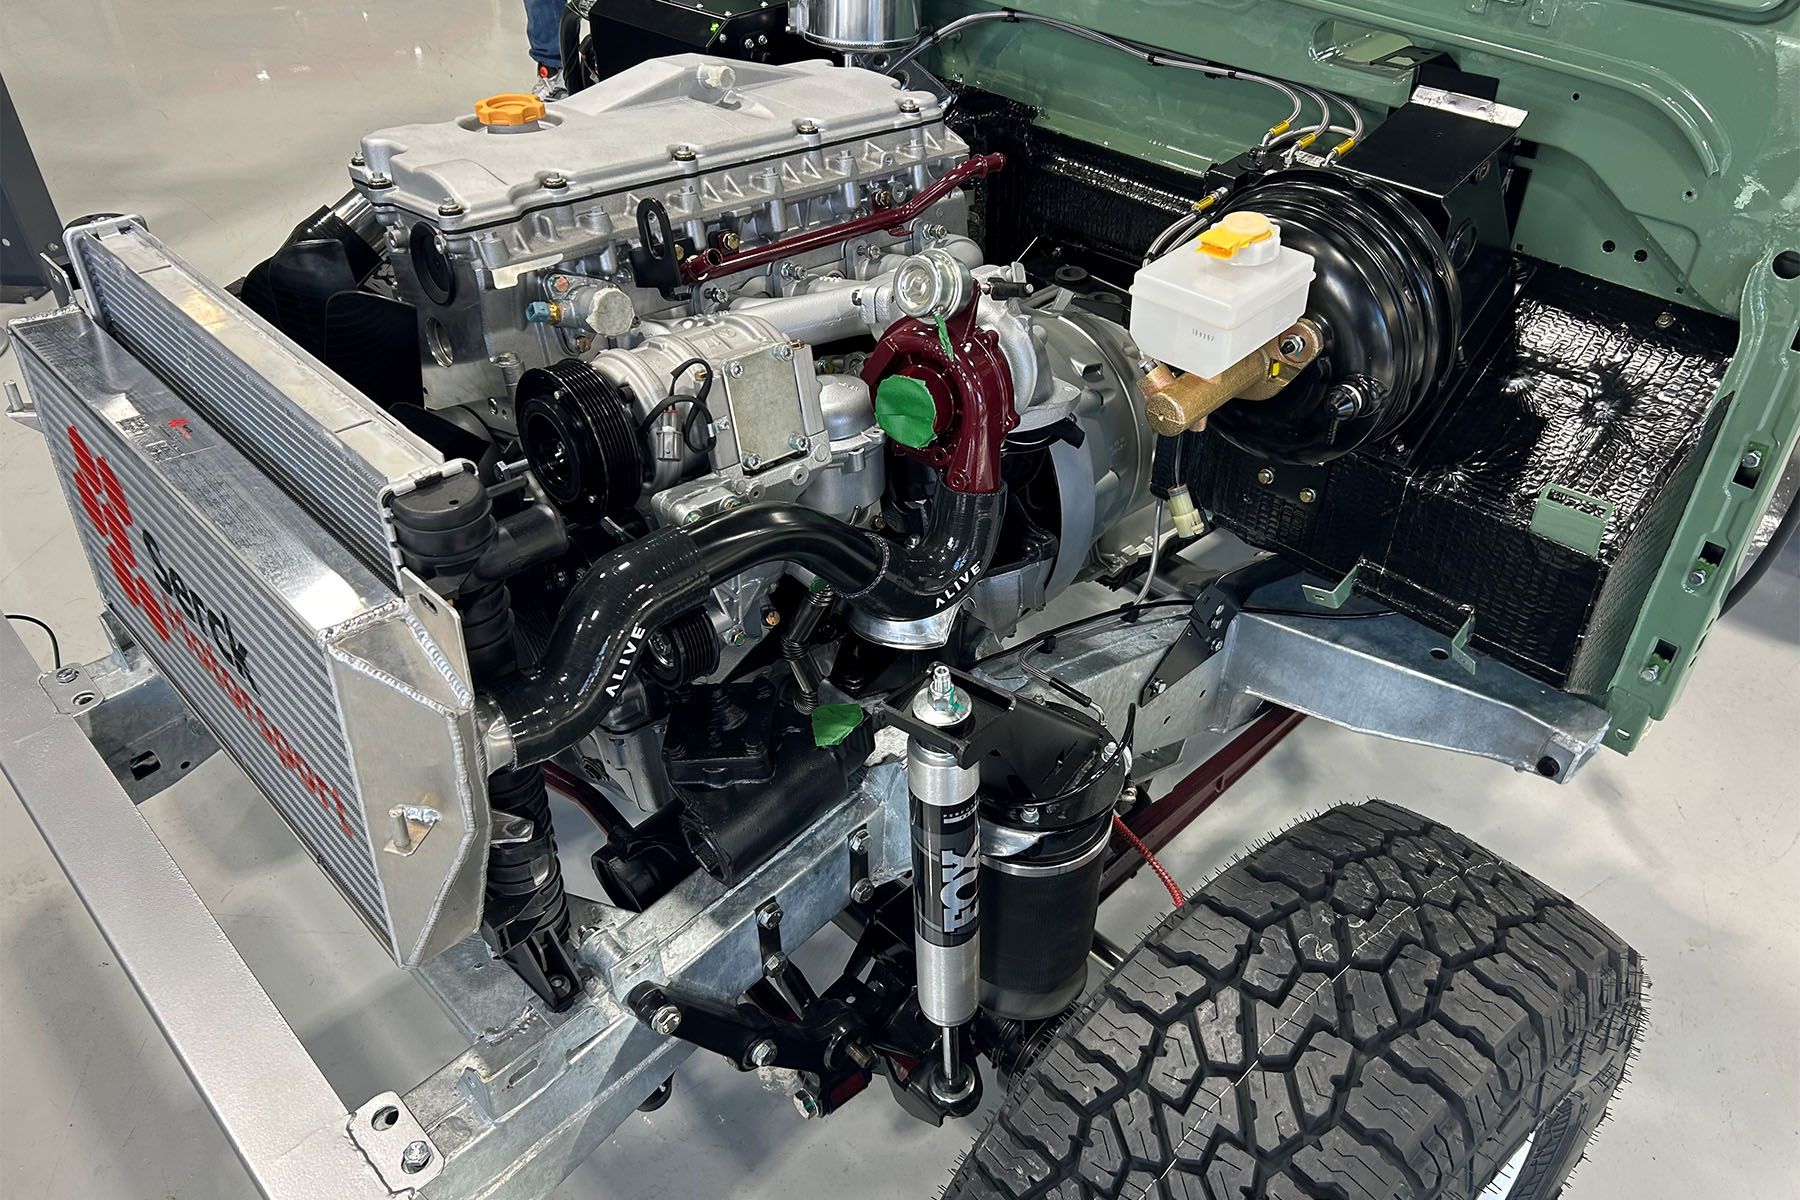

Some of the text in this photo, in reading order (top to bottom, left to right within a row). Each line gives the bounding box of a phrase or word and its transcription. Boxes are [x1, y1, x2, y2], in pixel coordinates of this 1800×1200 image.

[142, 529, 260, 697] Serck
[935, 560, 981, 609] ALIVE
[605, 625, 646, 698] ALIVE
[162, 592, 353, 838] Motorsport
[940, 833, 979, 933] FOX
